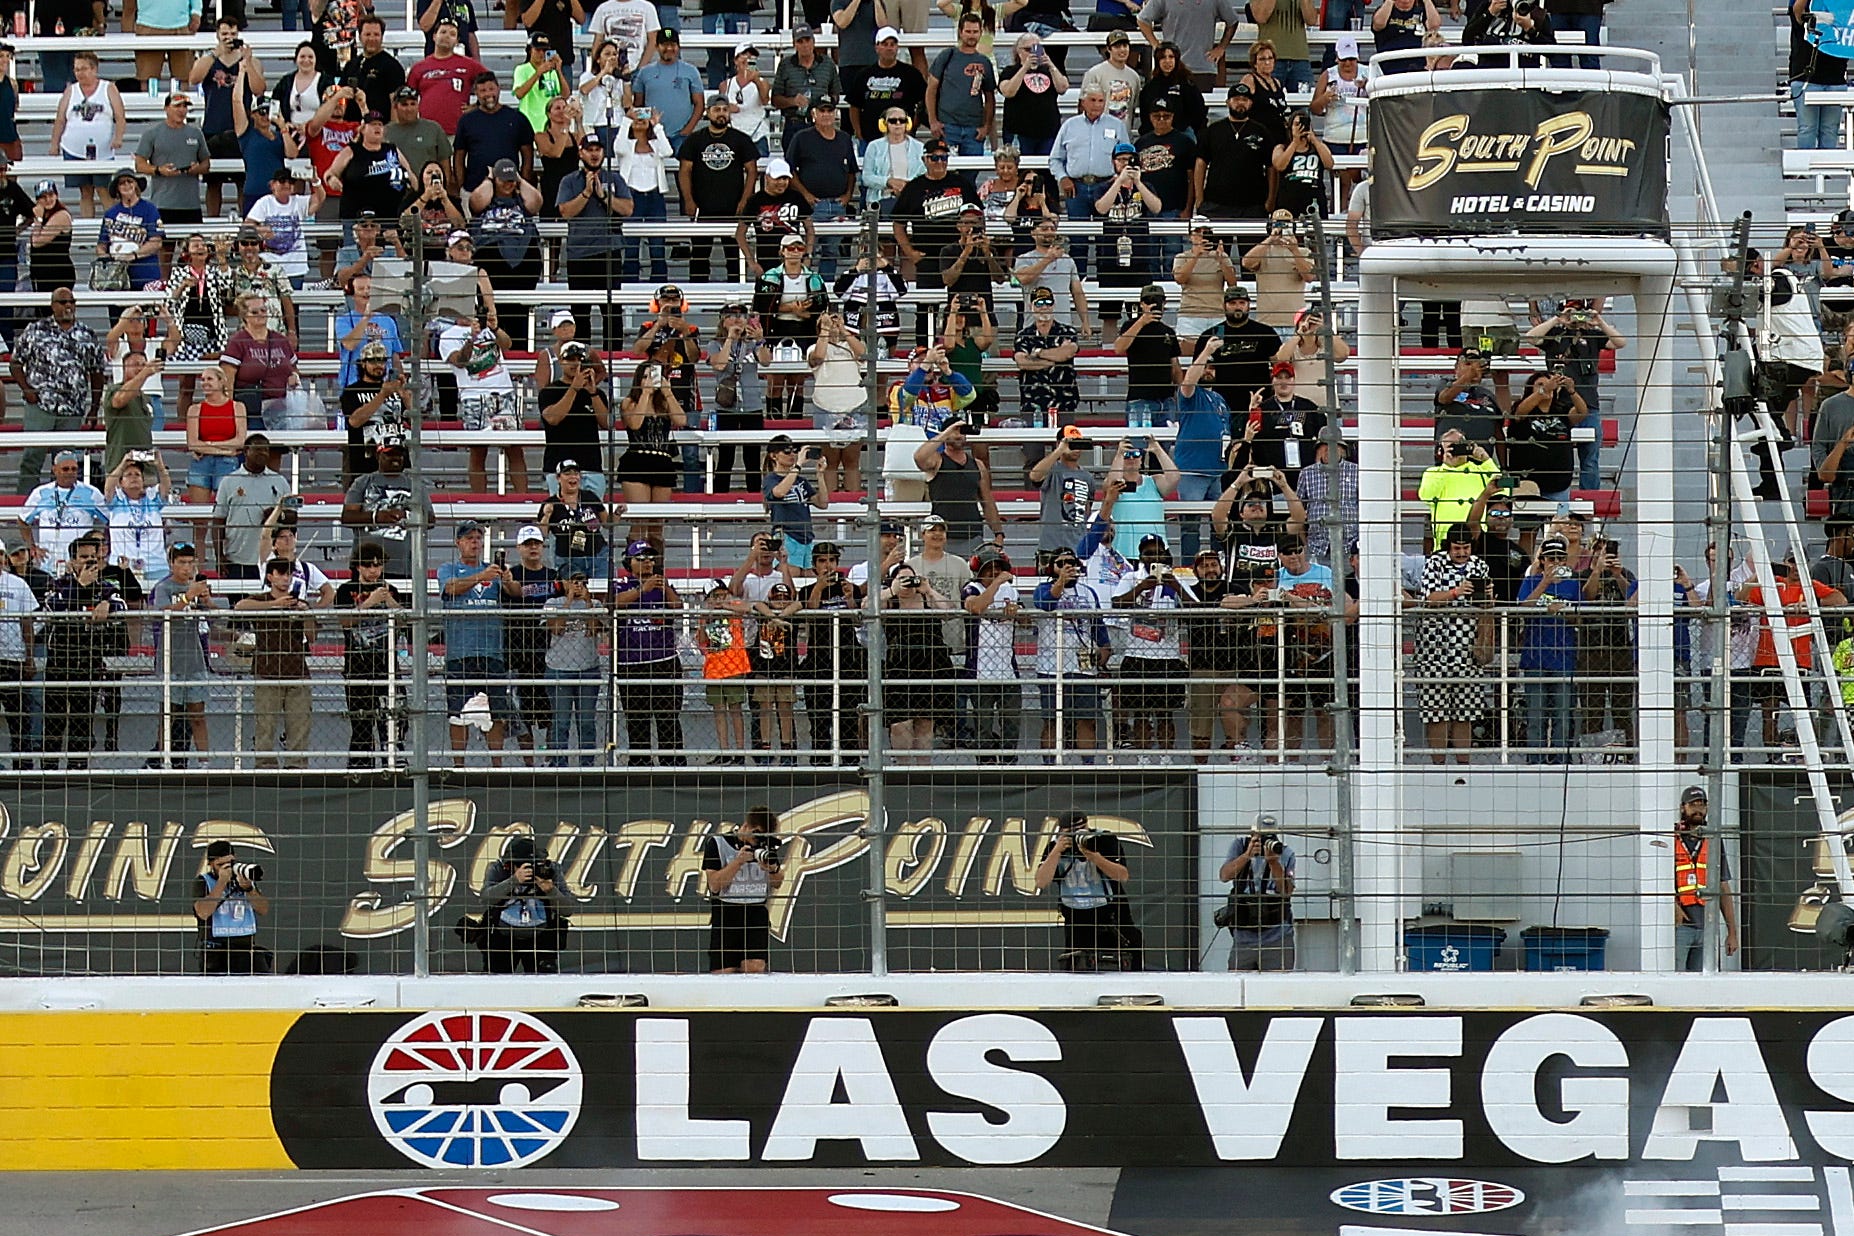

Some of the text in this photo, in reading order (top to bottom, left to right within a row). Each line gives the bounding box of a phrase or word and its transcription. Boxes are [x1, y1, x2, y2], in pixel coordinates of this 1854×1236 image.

[1293, 155, 1319, 170] 20
[1407, 110, 1635, 191] SOUTH POINT
[1450, 195, 1596, 214] HOTEL & CASINO
[1291, 421, 1304, 436] 8
[0, 803, 276, 905] OINT
[635, 1013, 1068, 1165] LAS
